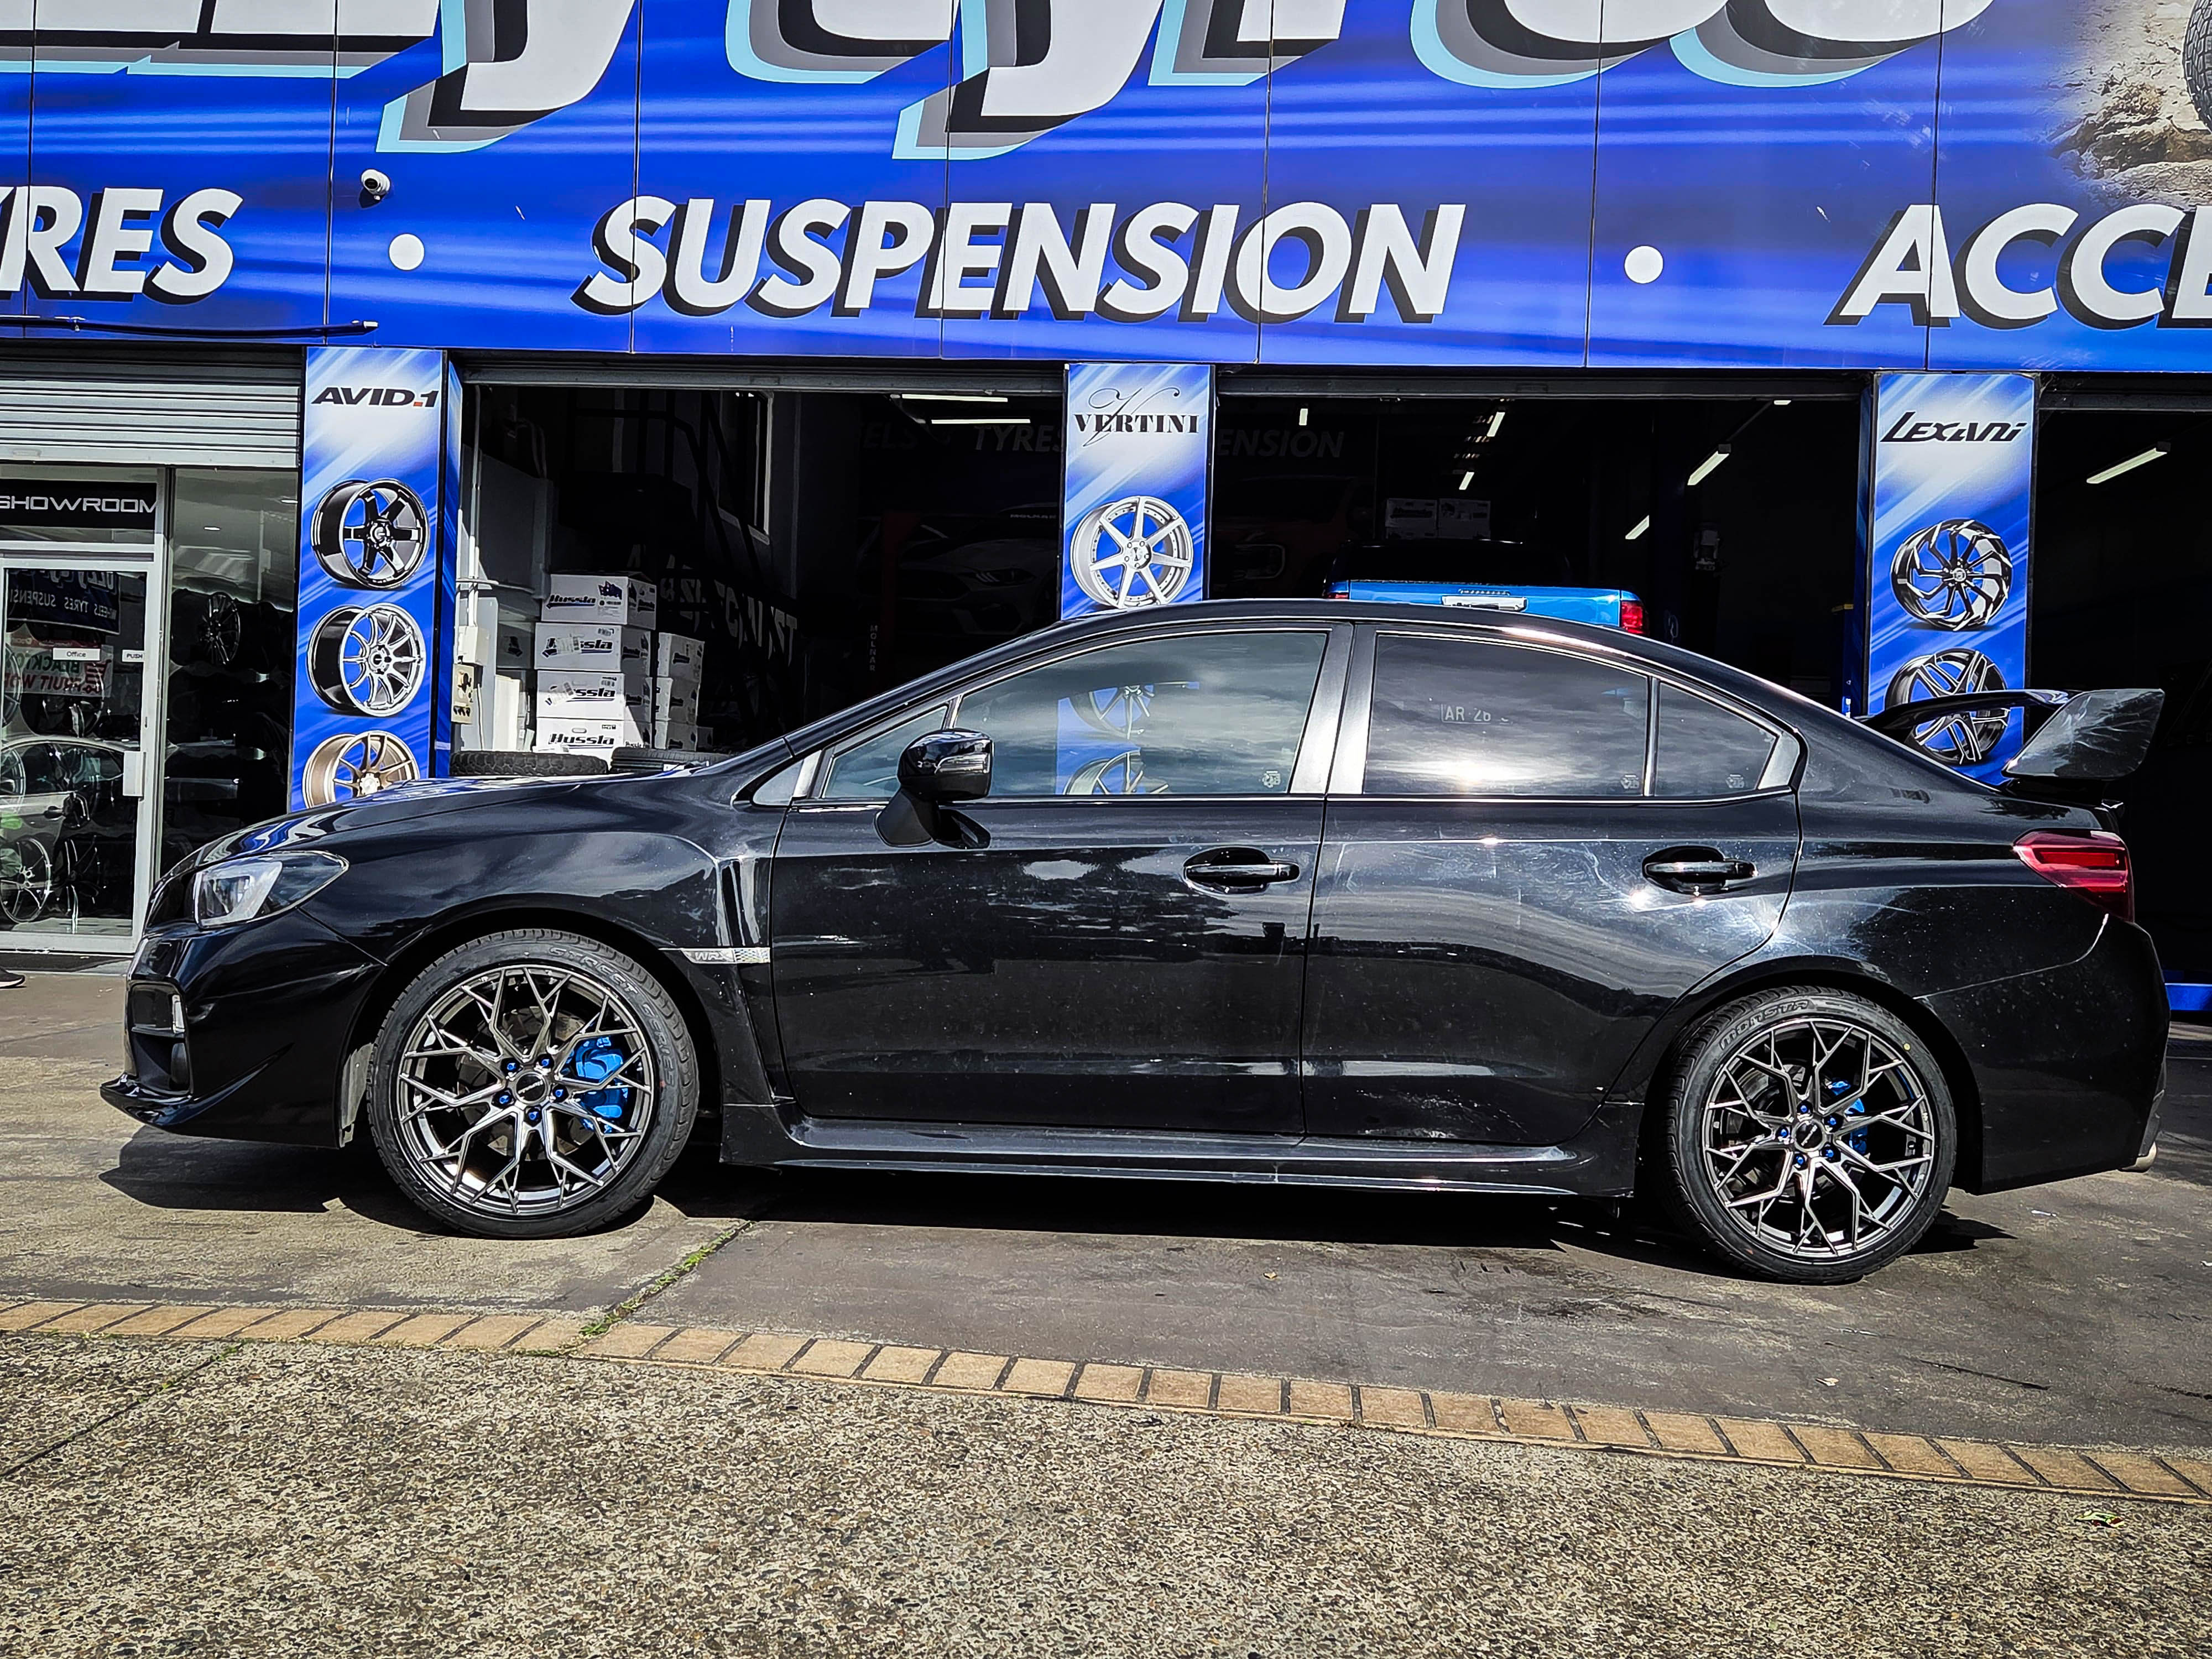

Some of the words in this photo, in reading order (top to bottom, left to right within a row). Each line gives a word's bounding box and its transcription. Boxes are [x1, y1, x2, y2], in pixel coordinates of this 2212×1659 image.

[582, 196, 1467, 317] SUSPENSION
[310, 387, 439, 408] AVID.1
[1074, 414, 1199, 434] VERTINI
[695, 951, 732, 961] WRX
[548, 946, 639, 997] STREET
